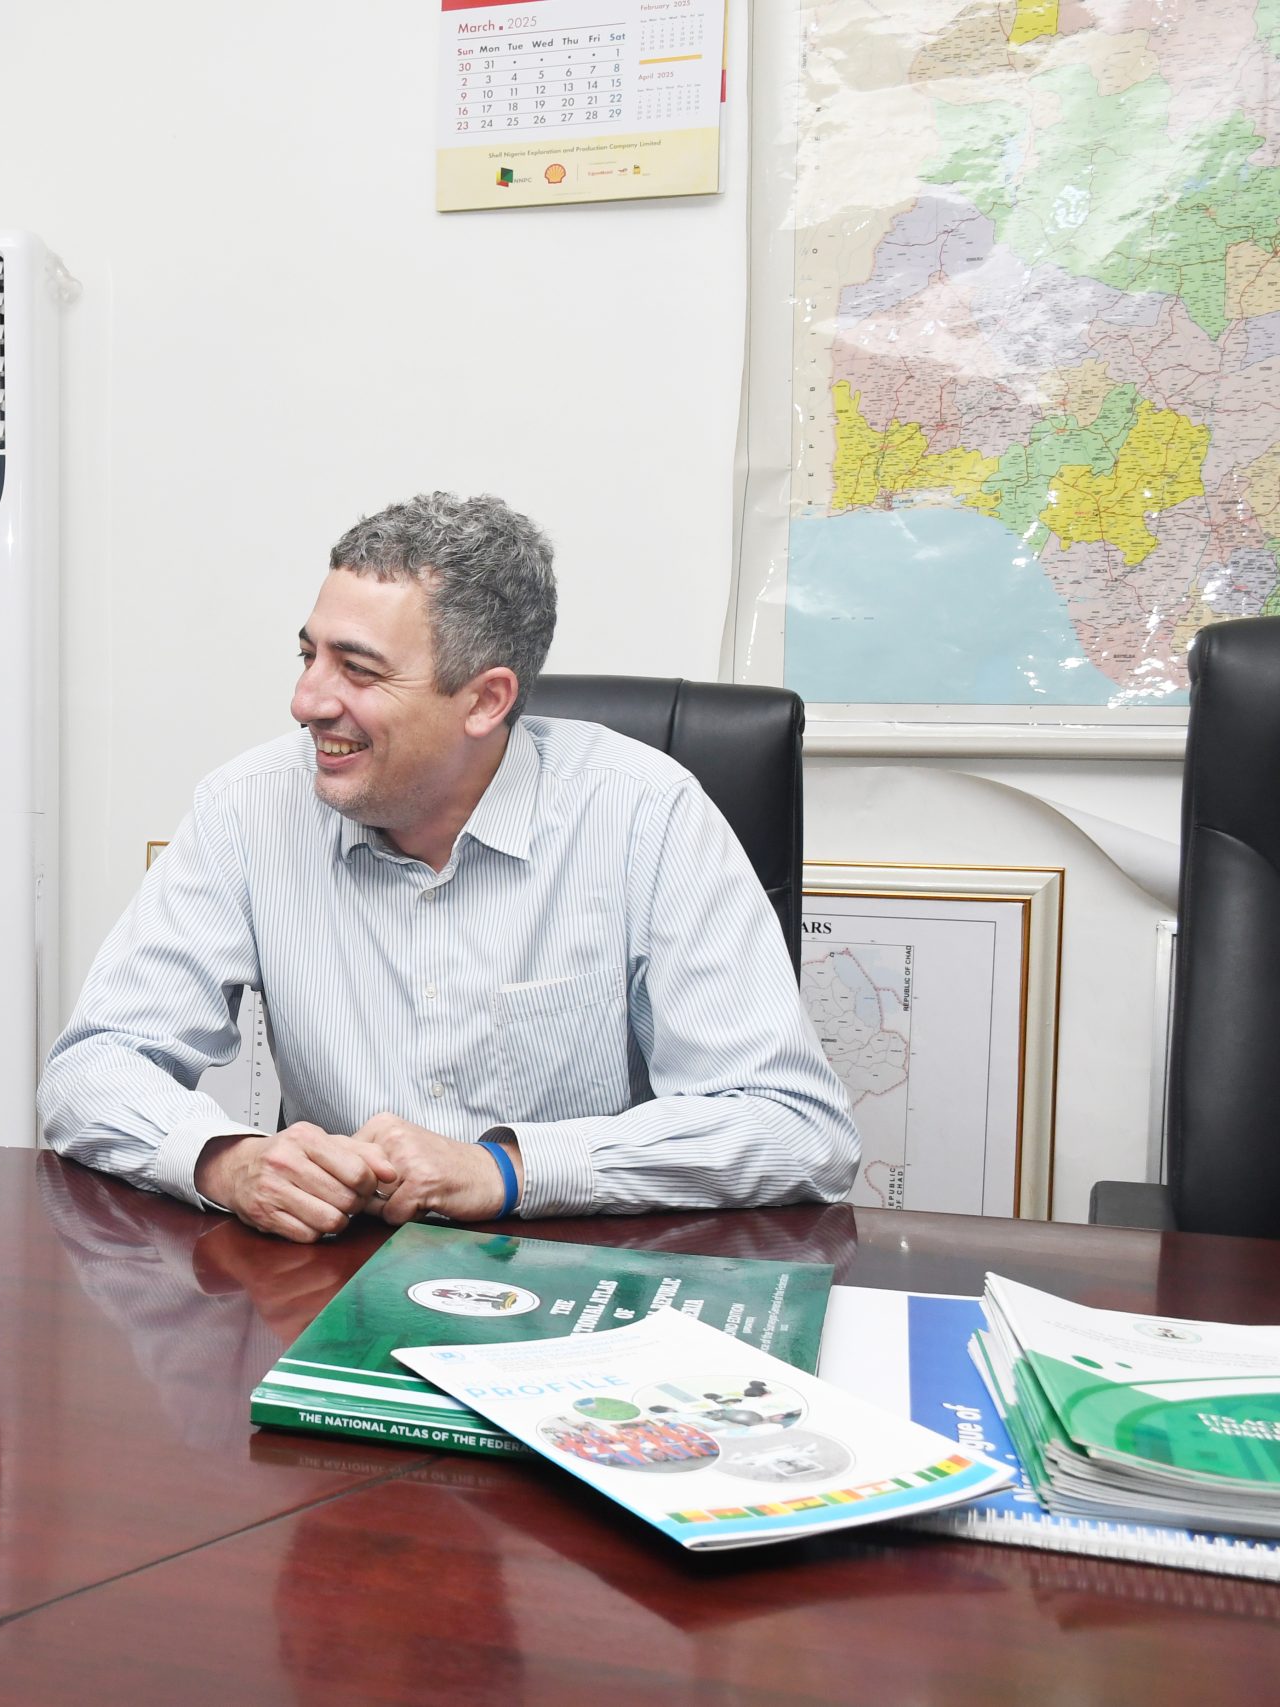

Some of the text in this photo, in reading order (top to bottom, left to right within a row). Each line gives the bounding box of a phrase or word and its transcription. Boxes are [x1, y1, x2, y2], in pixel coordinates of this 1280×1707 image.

[640, 0, 691, 11] February 2025
[458, 16, 537, 34] March 2025
[457, 48, 474, 56] Sun
[508, 43, 523, 51] Tue
[532, 38, 554, 48] Wed
[562, 37, 579, 45] Thu
[588, 34, 600, 43] Fri
[610, 33, 626, 41] Sat
[458, 48, 620, 72] 30 31 1
[462, 63, 620, 86] 2 3 4 5 6 7 8
[460, 78, 622, 101] 9 10 11 12 13 14 15
[458, 93, 622, 116] 16 17 18 19 20 21 22
[456, 108, 622, 131] 23 24 25 26 27 28 29
[488, 151, 503, 159] Shell
[504, 150, 526, 159] Nigeria
[527, 148, 562, 157] Exploration
[575, 144, 608, 153] Production
[609, 142, 638, 151] Company
[639, 140, 662, 148] Limited
[801, 921, 832, 935] ARS
[905, 963, 911, 976] OF
[903, 978, 911, 1011] REPUBLIC
[253, 1090, 261, 1127] BLIC
[888, 1167, 896, 1207] EPUBLIC
[549, 1298, 576, 1315] THE
[572, 1279, 618, 1334] TIONAL ATLAS
[613, 1307, 635, 1319] OF
[464, 1375, 630, 1399] PROFILE
[298, 1412, 322, 1425] THE
[324, 1416, 387, 1433] NATIONAL
[390, 1424, 429, 1439] ATLAS
[431, 1430, 449, 1442] OF
[452, 1433, 476, 1446] THE
[942, 1402, 996, 1452] gue of
